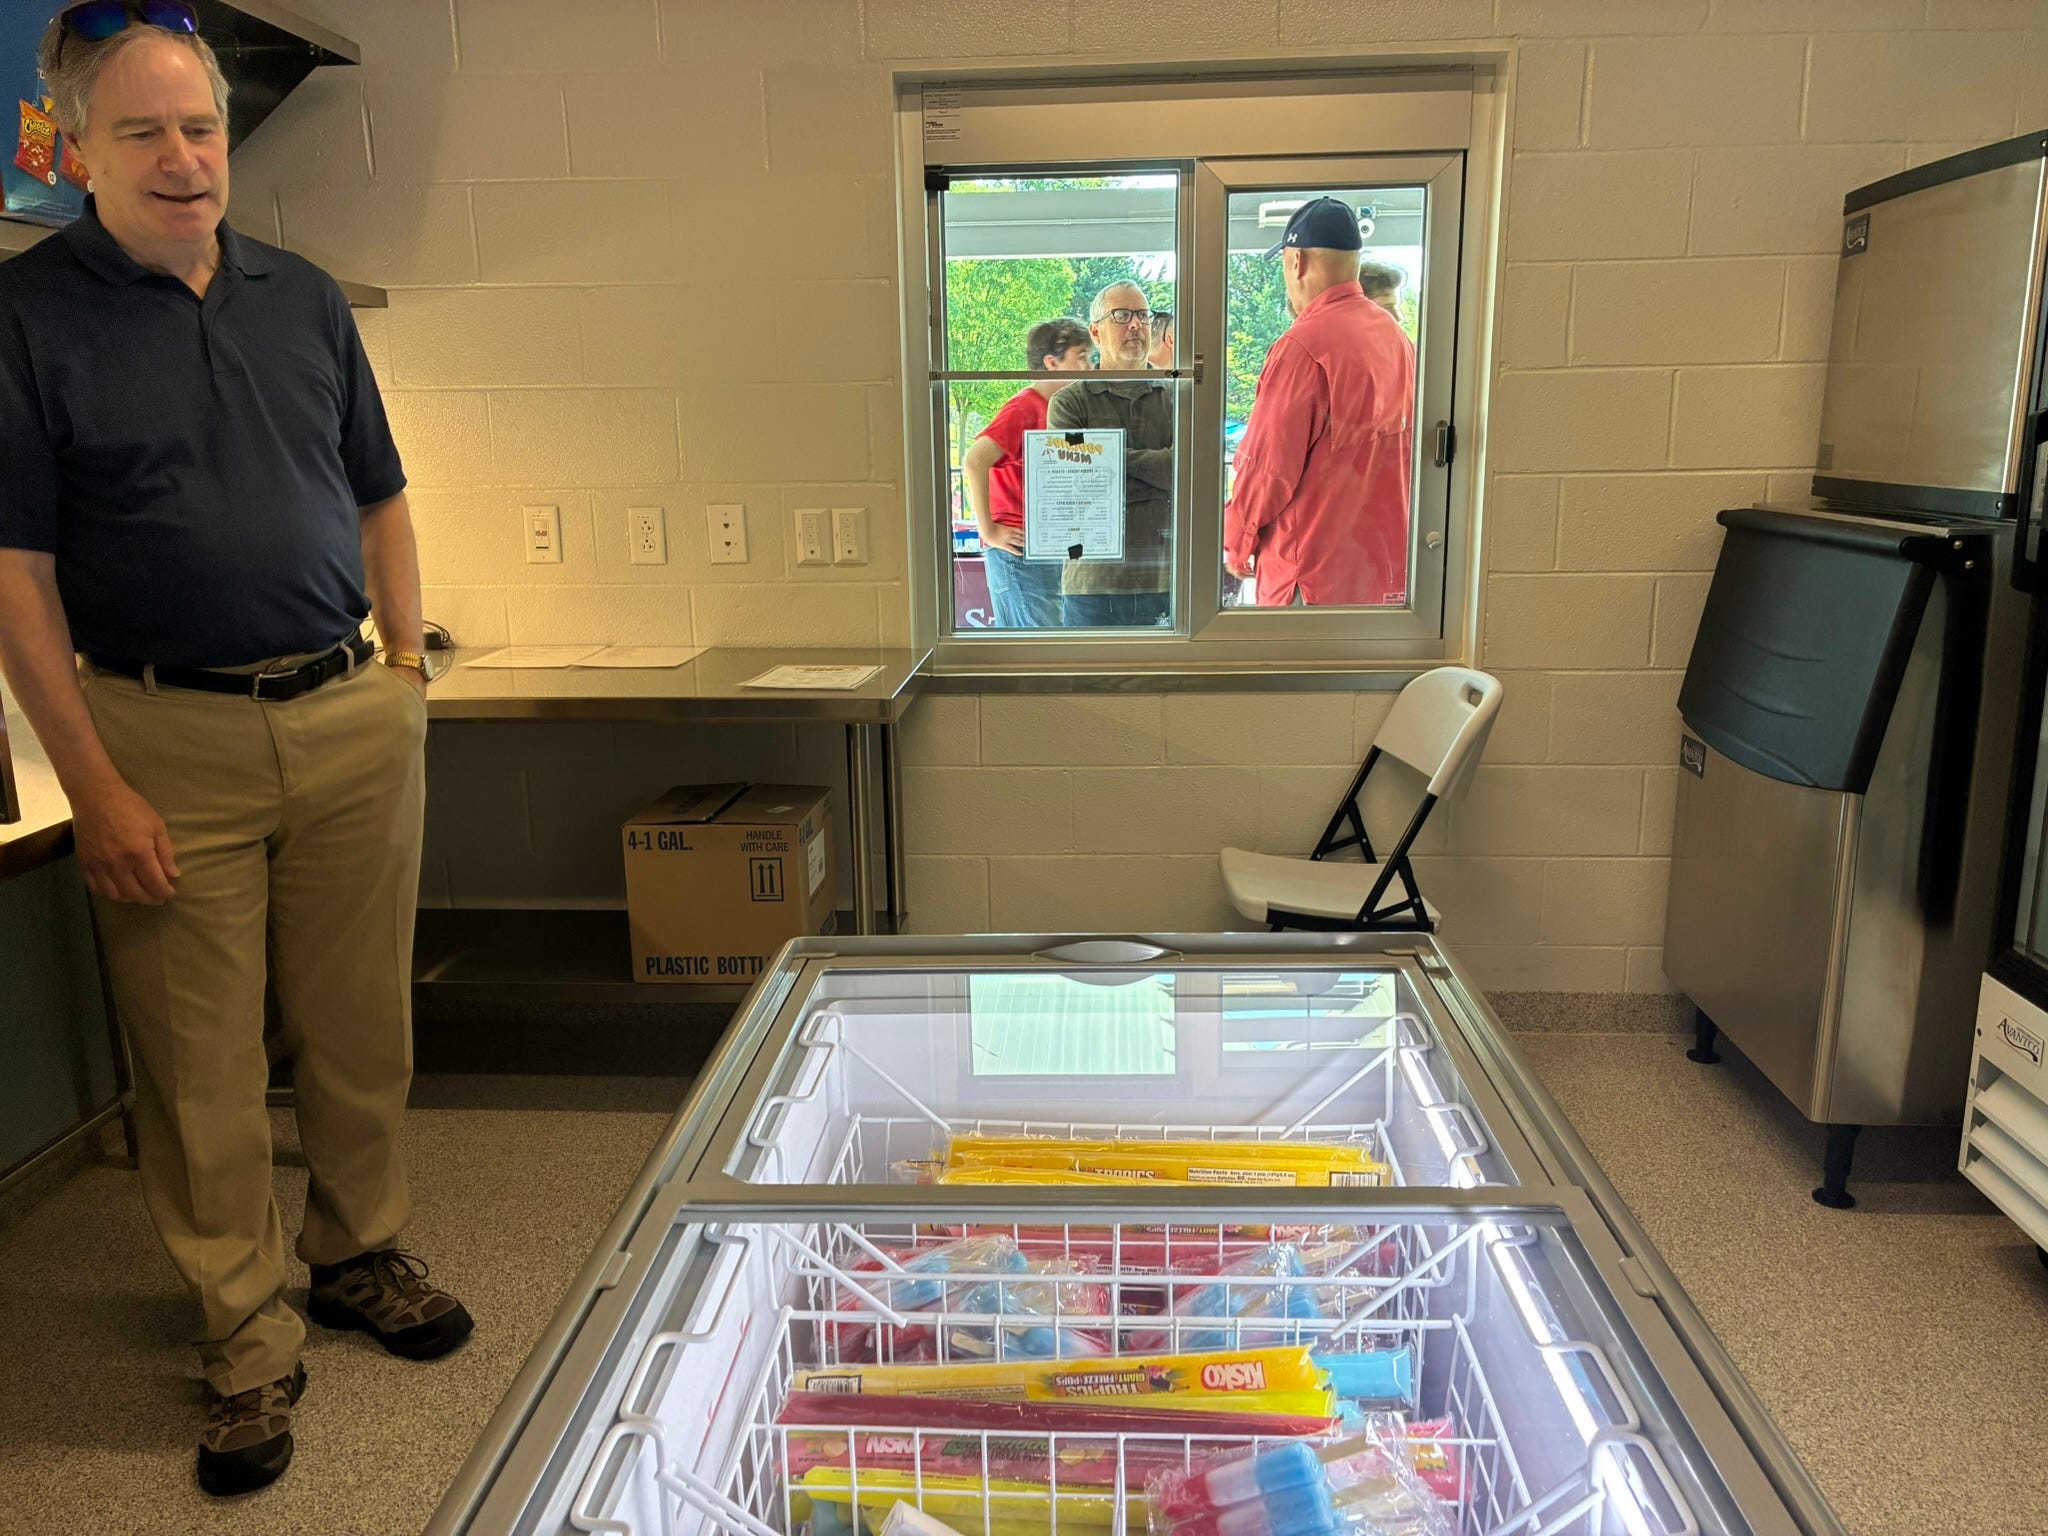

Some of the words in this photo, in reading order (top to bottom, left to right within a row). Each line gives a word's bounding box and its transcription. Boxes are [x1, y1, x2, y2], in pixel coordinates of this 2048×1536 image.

[24, 119, 51, 137] Cheetos
[628, 831, 652, 850] 4-1
[658, 831, 693, 850] GAL.
[746, 830, 783, 840] HANDLE
[740, 842, 762, 852] WITH
[765, 842, 790, 852] CARE
[646, 956, 710, 976] PLASTIC
[717, 956, 770, 976] BOTTL
[1997, 1018, 2041, 1060] AVANTCO
[1056, 1375, 1080, 1387] POPS
[1083, 1373, 1115, 1385] FREEZE
[1119, 1372, 1146, 1383] GIANT
